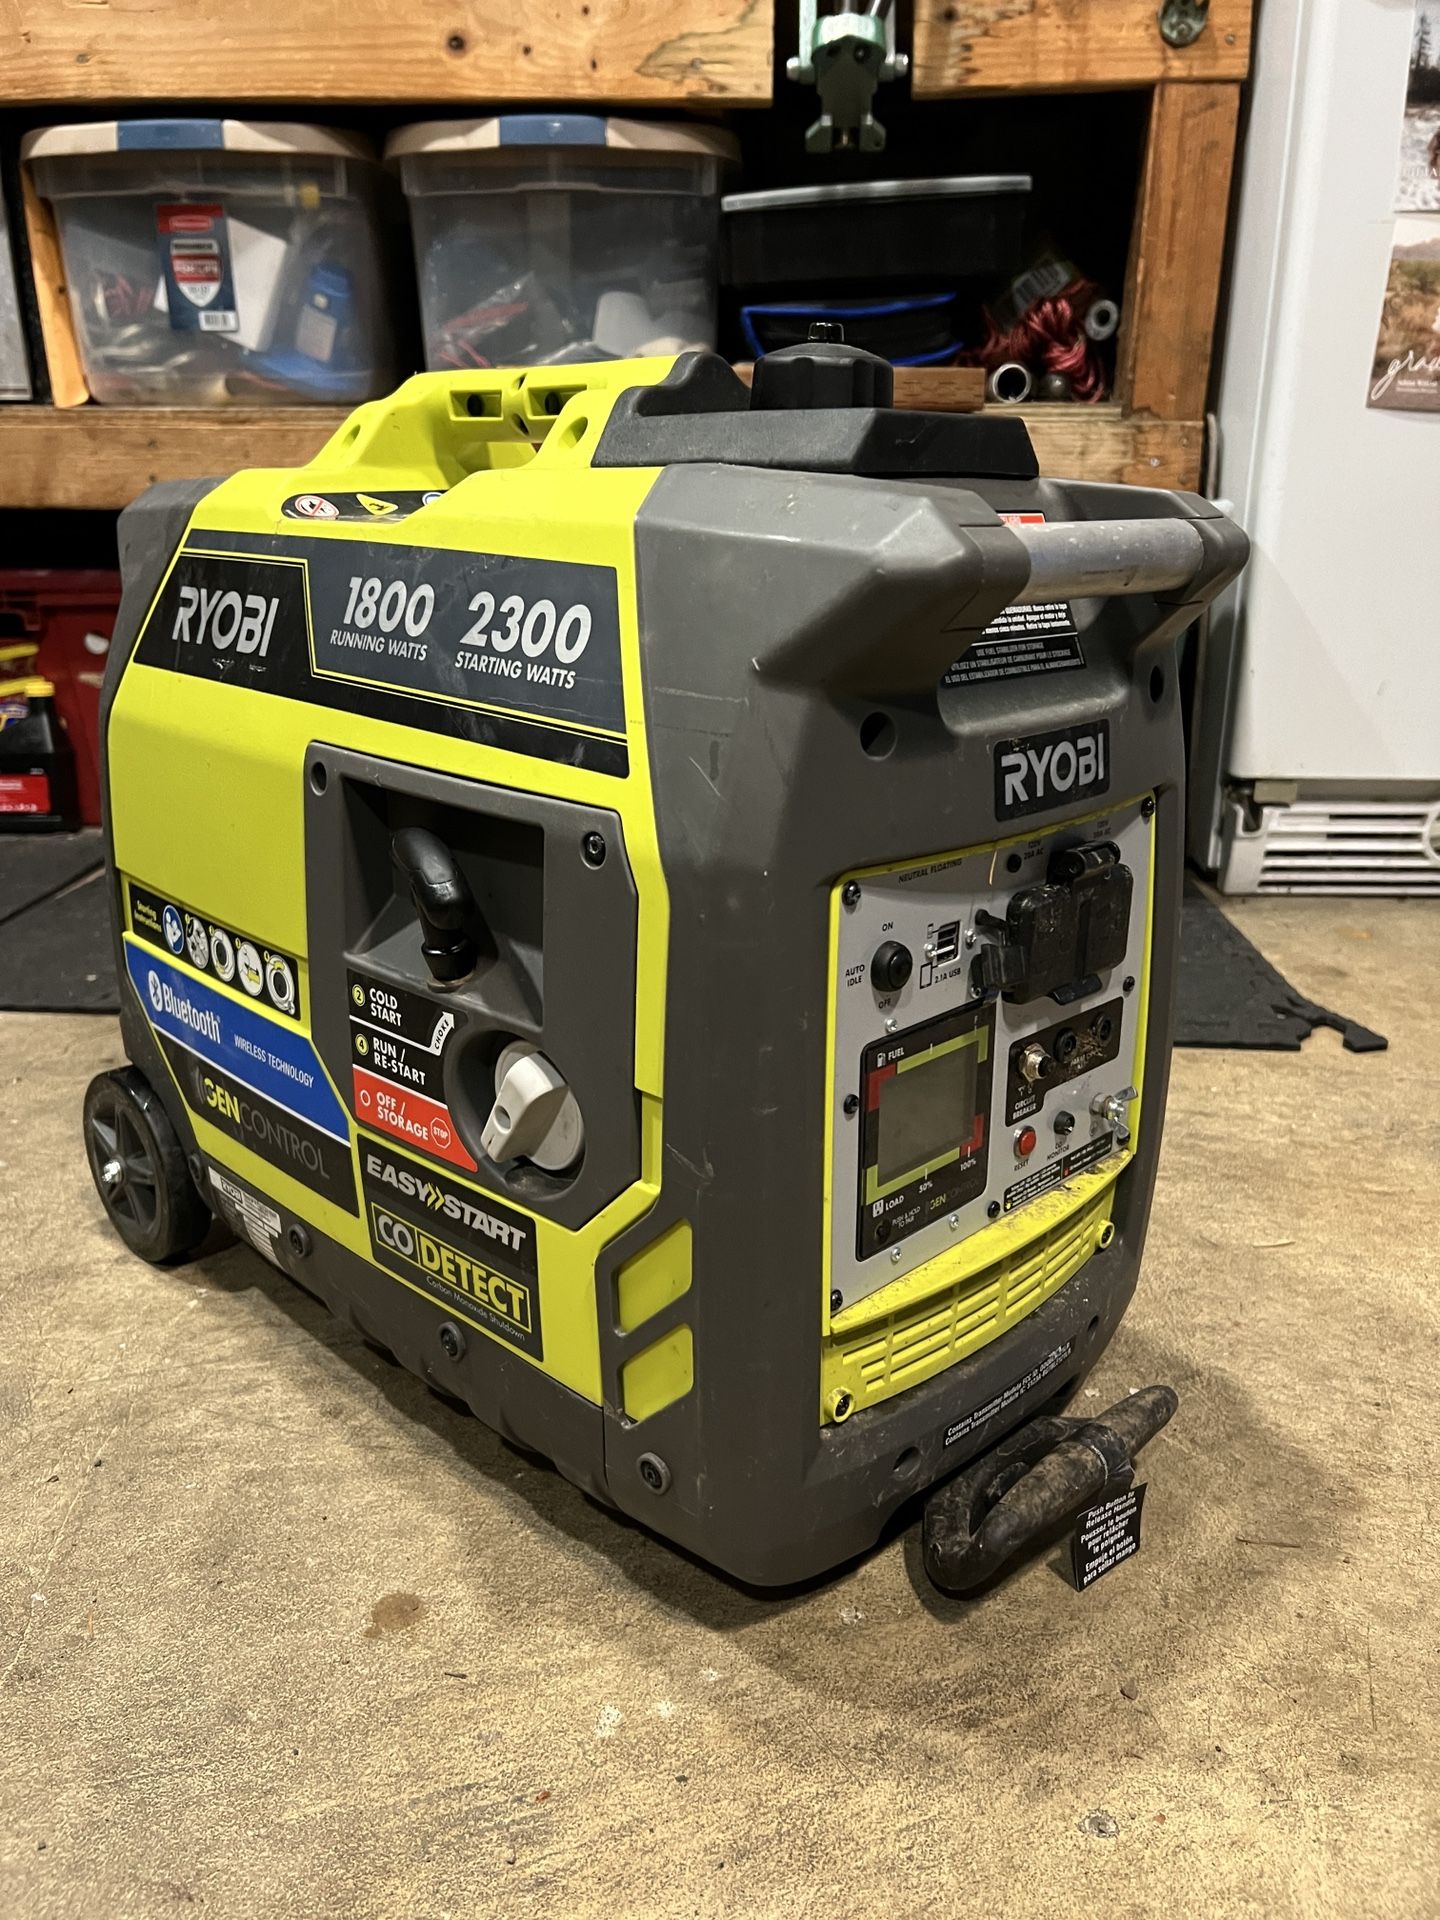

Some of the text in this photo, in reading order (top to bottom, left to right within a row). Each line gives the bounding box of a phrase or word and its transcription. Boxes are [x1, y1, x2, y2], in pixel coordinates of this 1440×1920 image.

[172, 587, 279, 656] RYOBI
[343, 576, 592, 664] 1800 2300
[330, 630, 428, 661] RUNNING WATTS
[455, 651, 576, 689] STARTING WATTS
[1001, 733, 1104, 805] RYOBI
[899, 858, 962, 883] NEUTRAL FLOATING
[882, 922, 893, 932] ON
[845, 964, 865, 977] AUTO
[847, 975, 862, 987] IDLE
[949, 967, 961, 978] USB
[356, 989, 362, 1001] 2
[370, 988, 398, 1009] COLD
[878, 998, 891, 1009] OFF
[371, 1003, 401, 1027] START
[358, 1039, 365, 1050] 4
[434, 1019, 449, 1050] CHOKE
[234, 1034, 315, 1088] WIRELESS TECHNOLOGY
[373, 1037, 406, 1062] RUN /
[888, 1047, 905, 1061] FUEL
[374, 1052, 426, 1086] RE-START
[376, 1091, 406, 1115] OFF /
[1012, 1103, 1037, 1120] BREAKER
[378, 1106, 429, 1140] STORAGE
[432, 1125, 449, 1140] STOP
[960, 1158, 976, 1171] 100%
[1047, 1144, 1070, 1161] MONITOR
[1014, 1159, 1029, 1171] RESET
[919, 1180, 933, 1193] 50%
[367, 1154, 526, 1251] EASY START
[885, 1195, 904, 1211] LOAD
[378, 1214, 525, 1321] CO DETECT
[426, 1275, 525, 1341] Carbon Monoxide Shutdown
[945, 1426, 970, 1446] Contains
[948, 1416, 973, 1436] Contains
[1086, 1497, 1136, 1529] Release Handle
[1088, 1506, 1104, 1520] Push
[1105, 1494, 1127, 1510] Button
[1081, 1524, 1106, 1543] Poussez
[1115, 1506, 1137, 1523] bouton
[1083, 1542, 1136, 1586] para soltar mango
[1085, 1552, 1108, 1572] Empuje
